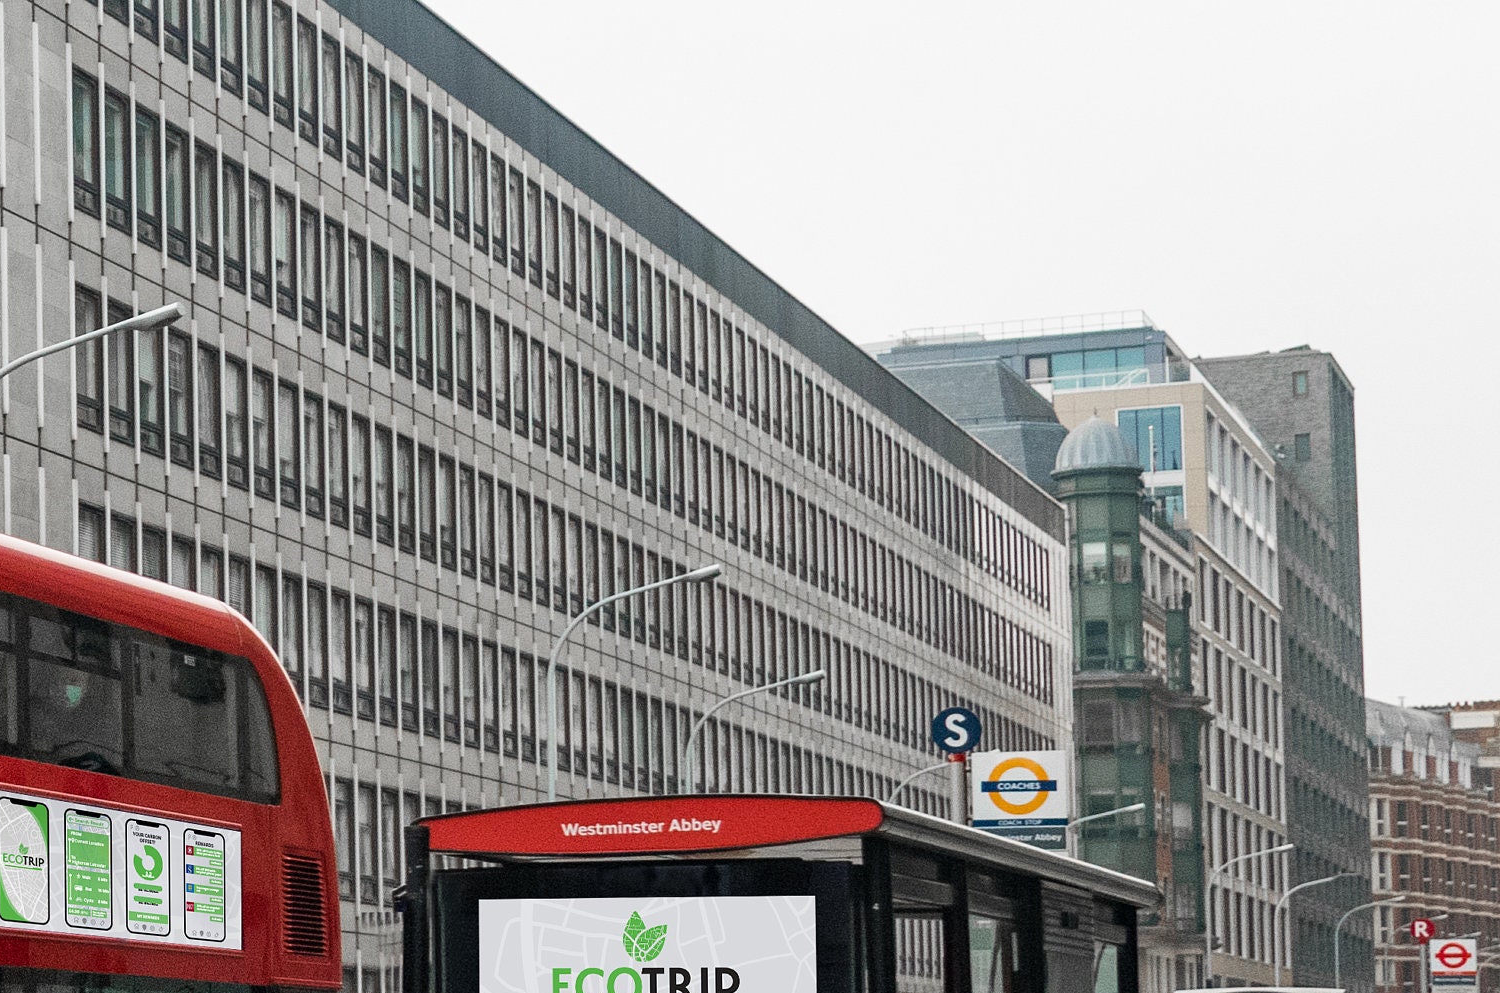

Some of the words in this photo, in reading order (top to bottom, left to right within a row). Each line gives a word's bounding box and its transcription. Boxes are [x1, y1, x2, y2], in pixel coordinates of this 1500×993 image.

[944, 713, 969, 748] S
[997, 782, 1041, 790] COACHES
[560, 820, 665, 837] Westminster
[668, 817, 722, 834] Abbey
[1034, 833, 1062, 842] Abbey
[2, 852, 45, 868] ECOTRIP
[1414, 921, 1429, 937] R
